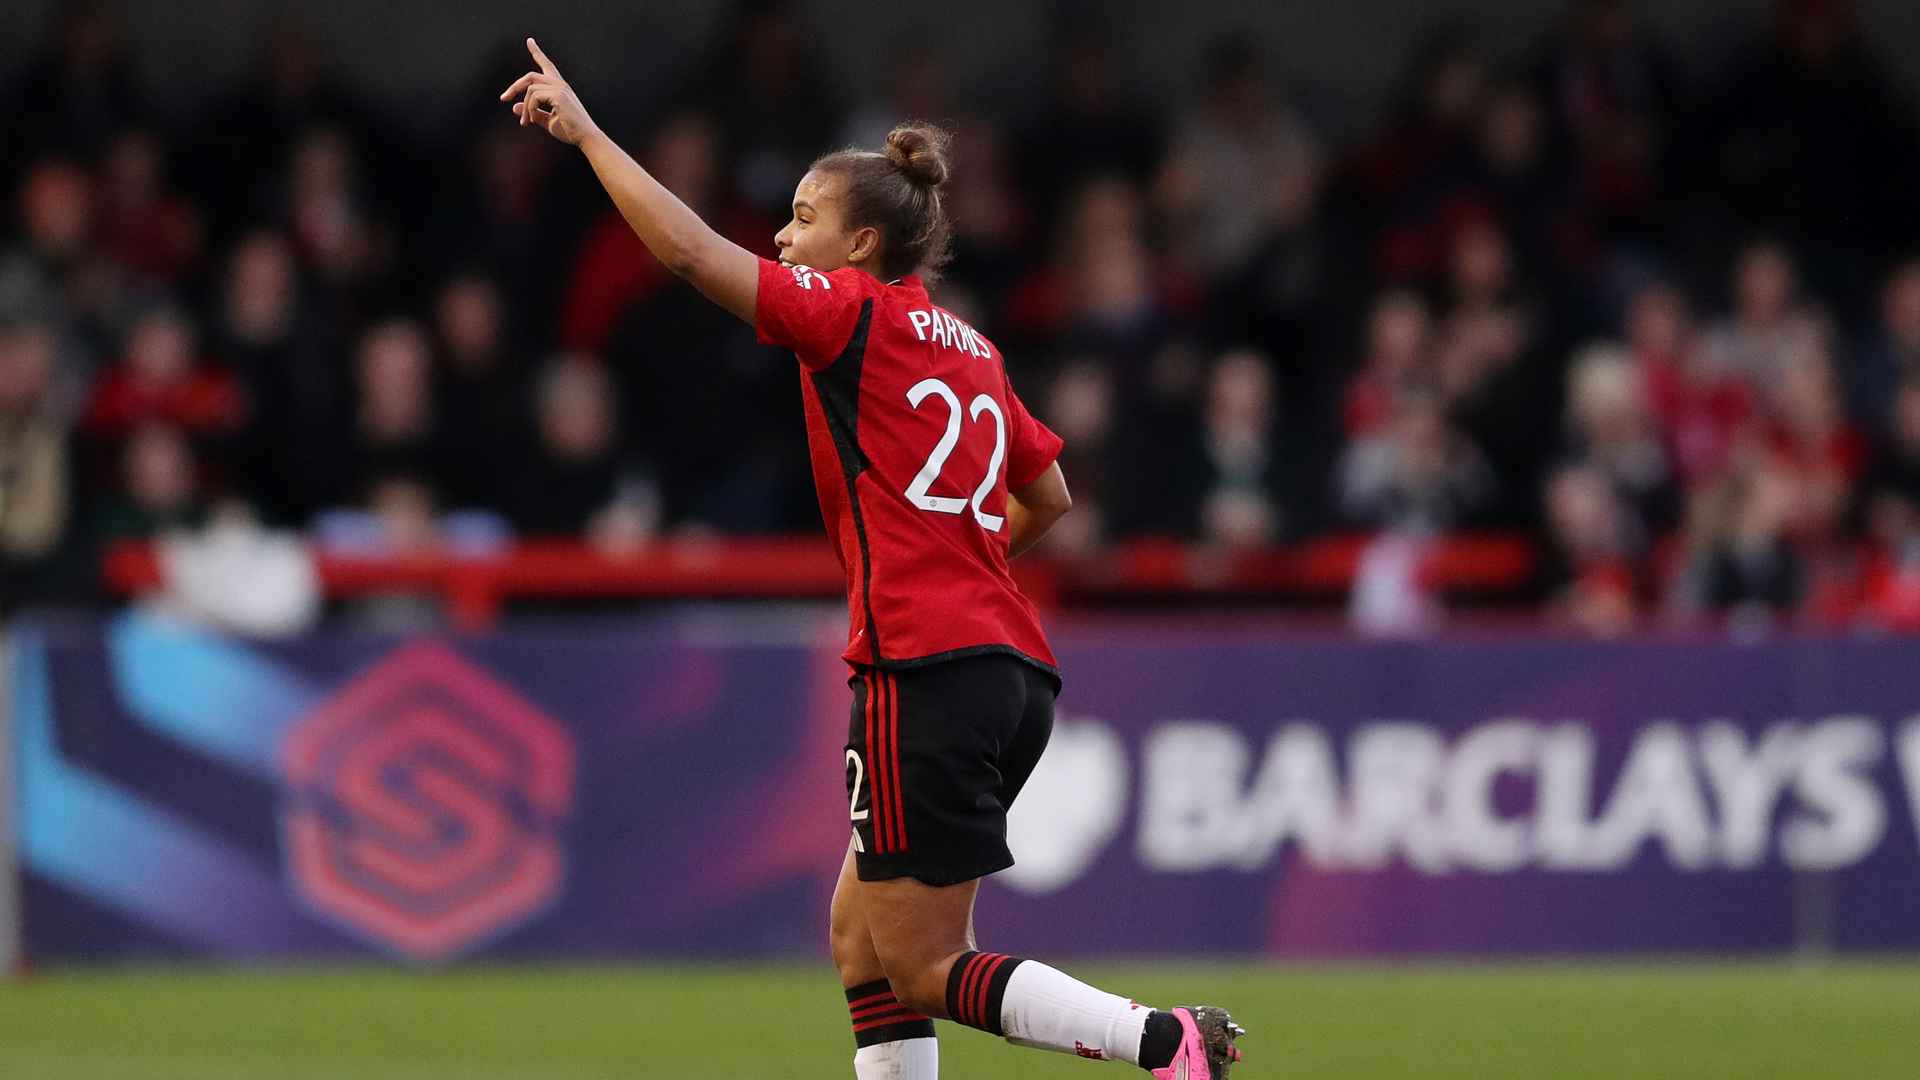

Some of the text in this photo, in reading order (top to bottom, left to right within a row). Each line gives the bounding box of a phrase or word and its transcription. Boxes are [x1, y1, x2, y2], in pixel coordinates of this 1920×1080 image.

[908, 308, 992, 359] PARRIS
[904, 378, 1005, 533] 22
[1142, 718, 1884, 874] BARCLAYS
